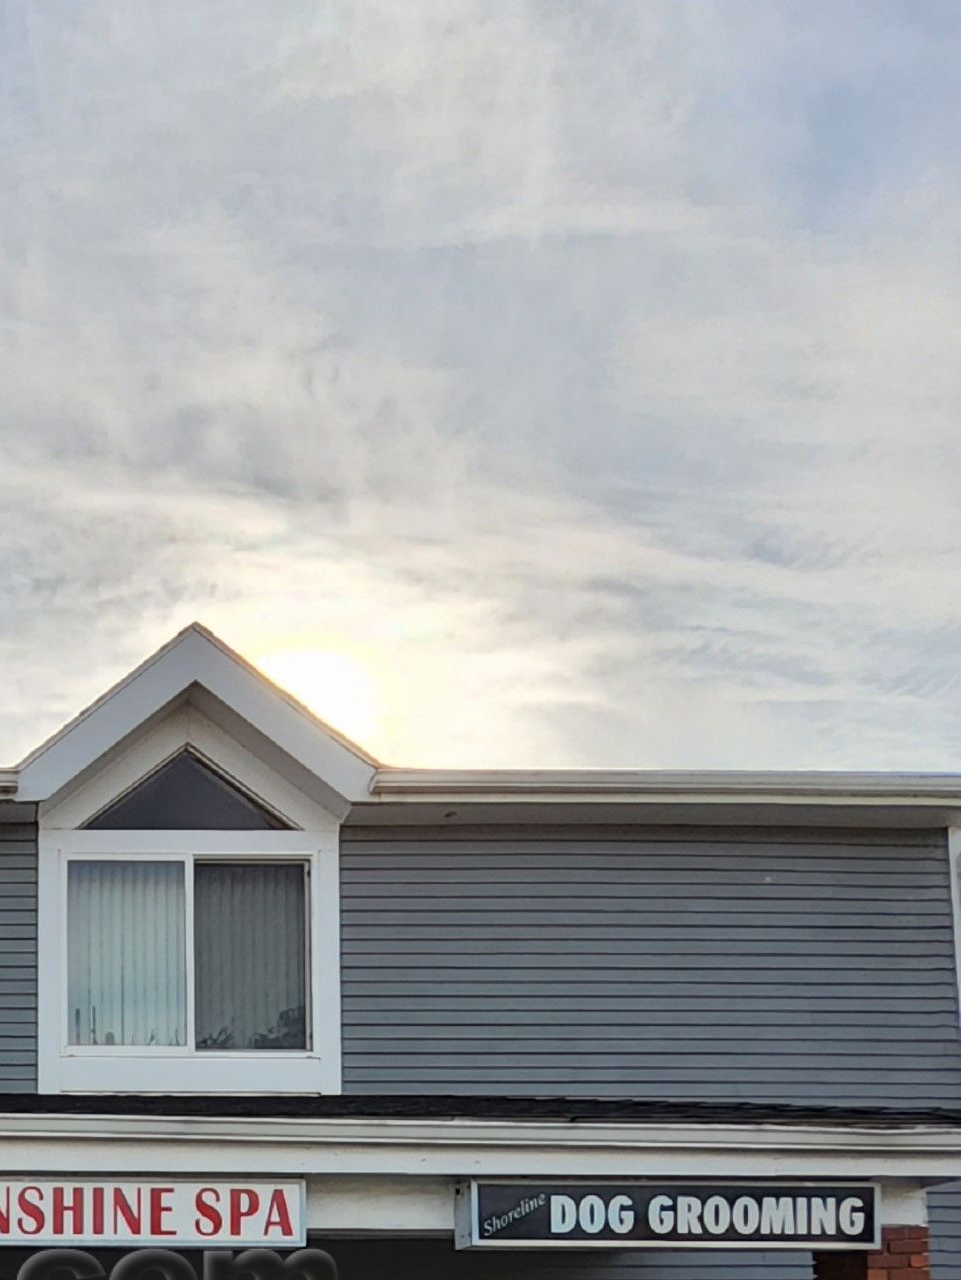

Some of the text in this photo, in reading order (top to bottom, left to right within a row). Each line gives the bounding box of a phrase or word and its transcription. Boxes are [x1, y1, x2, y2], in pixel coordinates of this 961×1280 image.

[194, 1187, 294, 1237] SPA
[483, 1193, 546, 1236] Shoreline
[550, 1194, 866, 1236] DOG GROOMING
